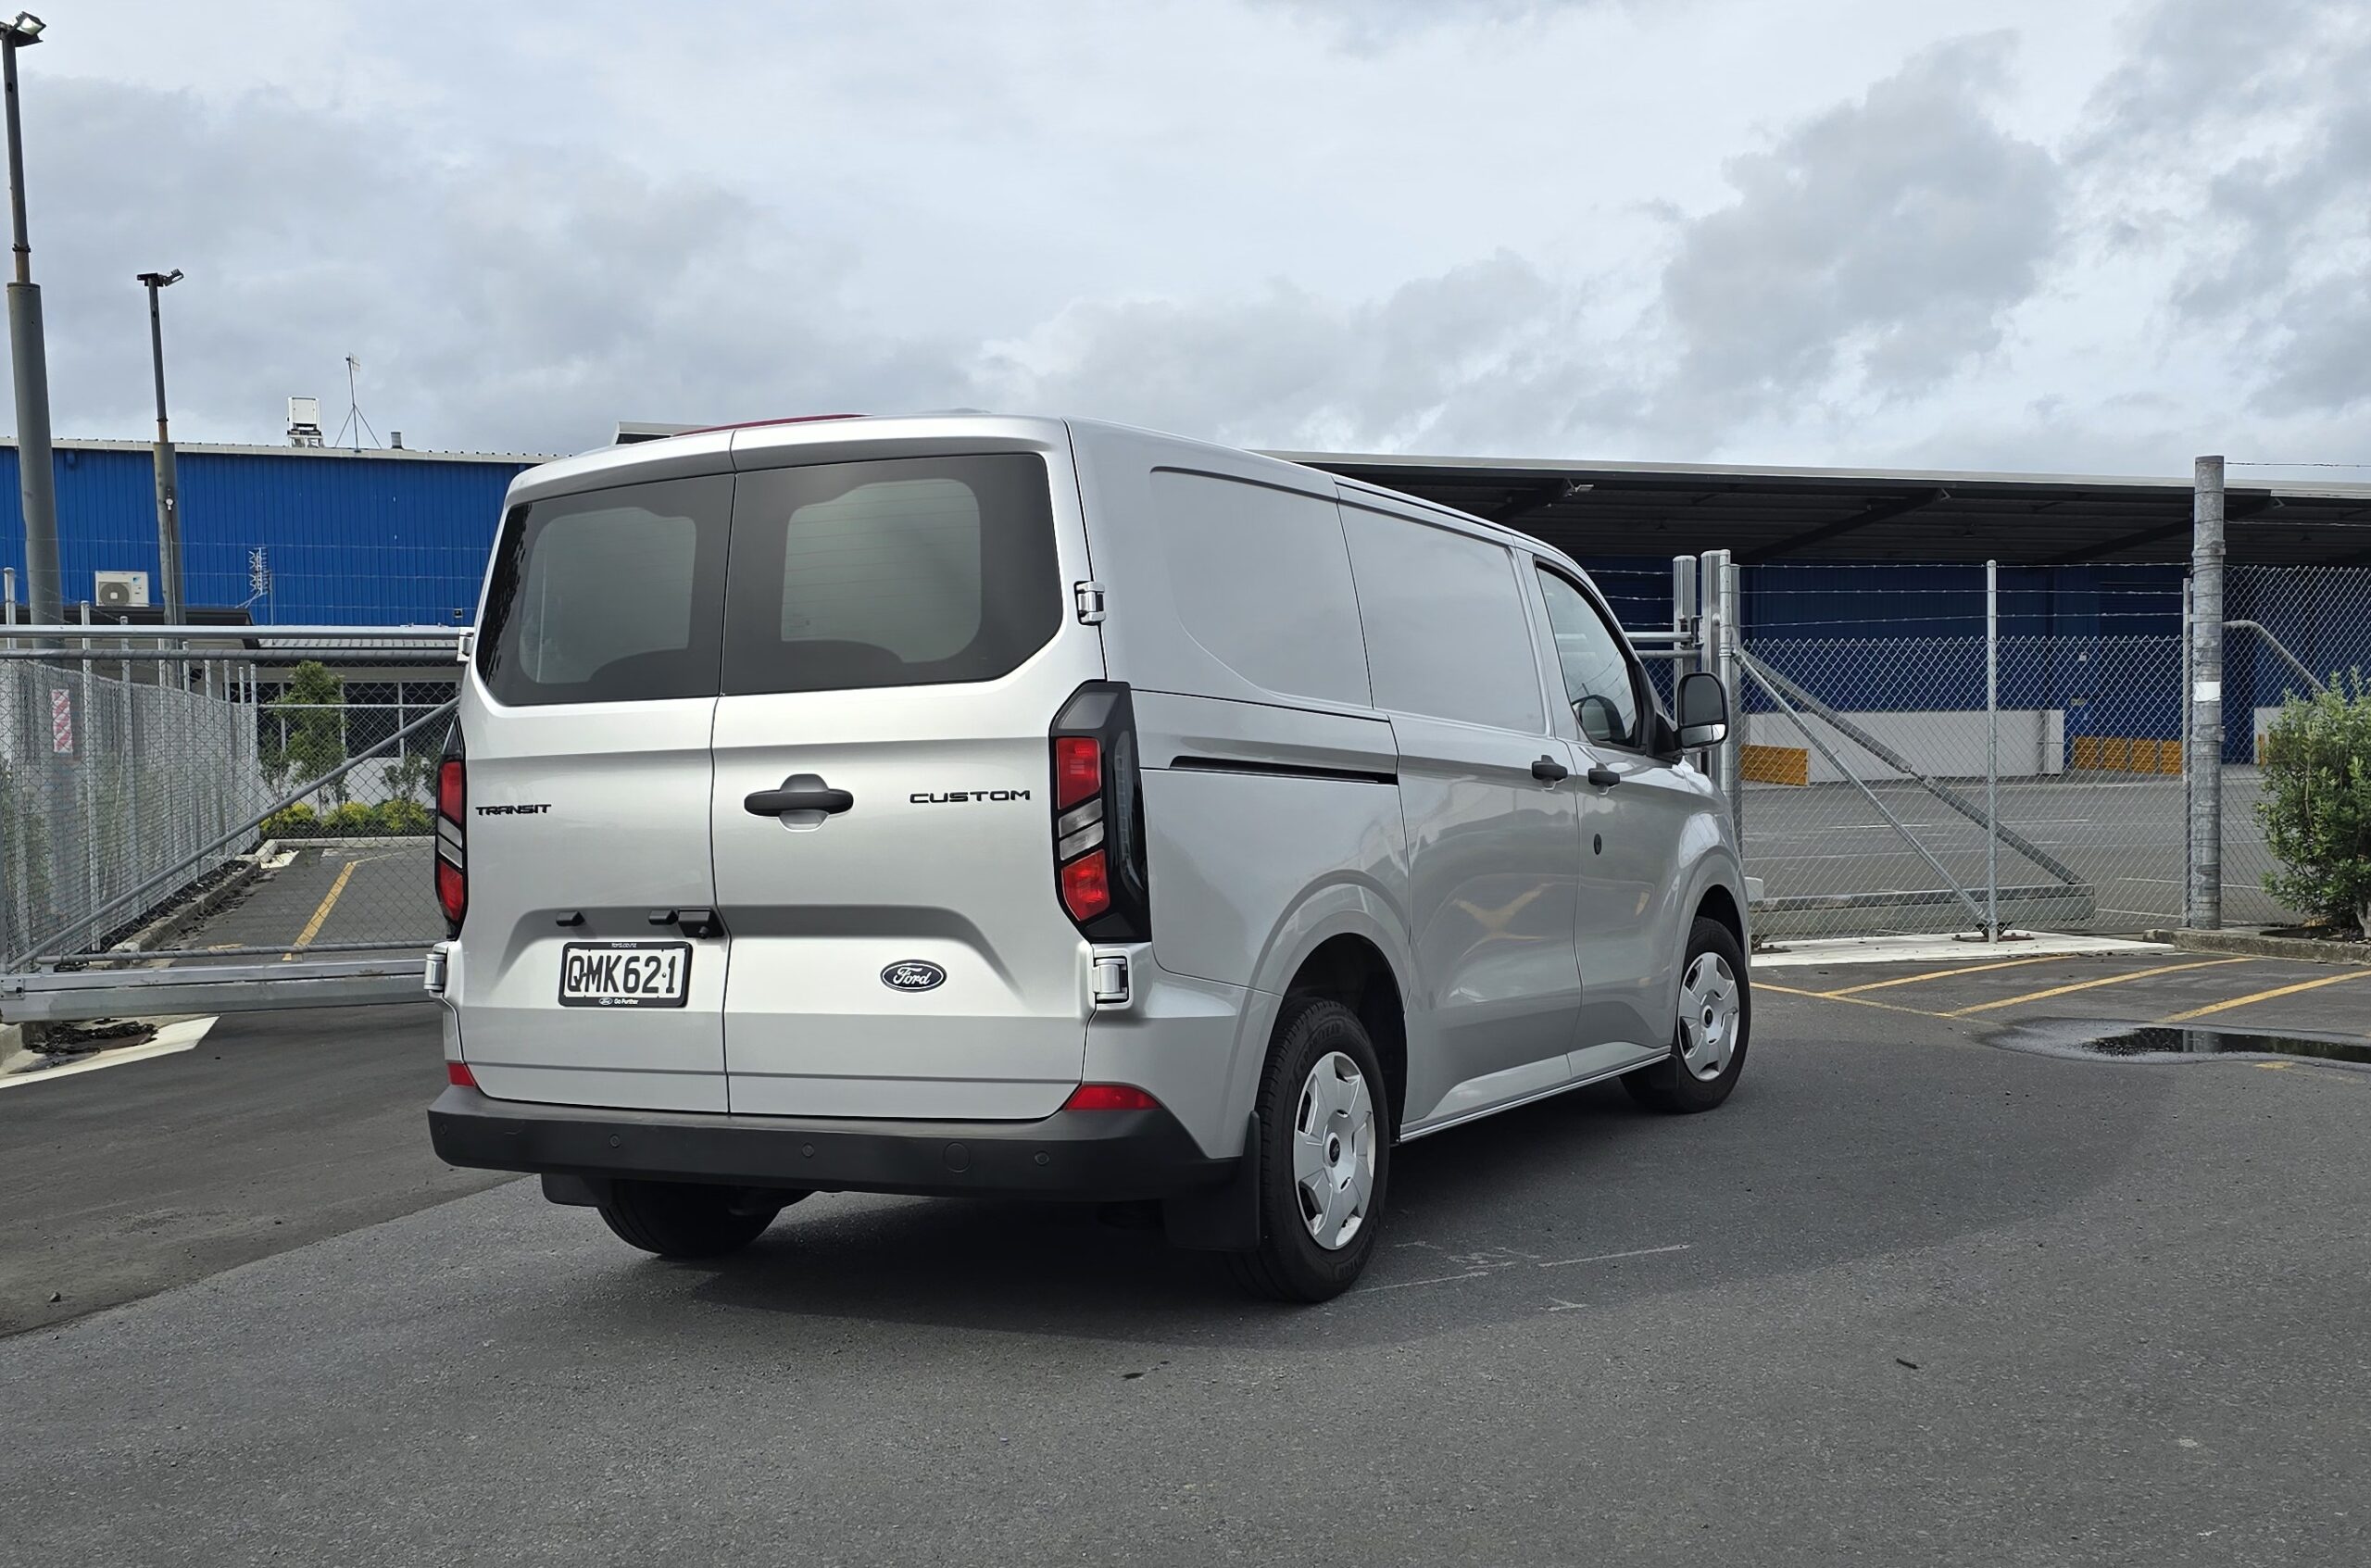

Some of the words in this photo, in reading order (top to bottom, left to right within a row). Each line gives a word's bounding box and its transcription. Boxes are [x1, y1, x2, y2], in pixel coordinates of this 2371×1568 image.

[910, 789, 1031, 803] CUSTOM
[475, 804, 552, 816] TRANSIT
[568, 955, 676, 994] QMK621
[893, 966, 933, 985] Ford
